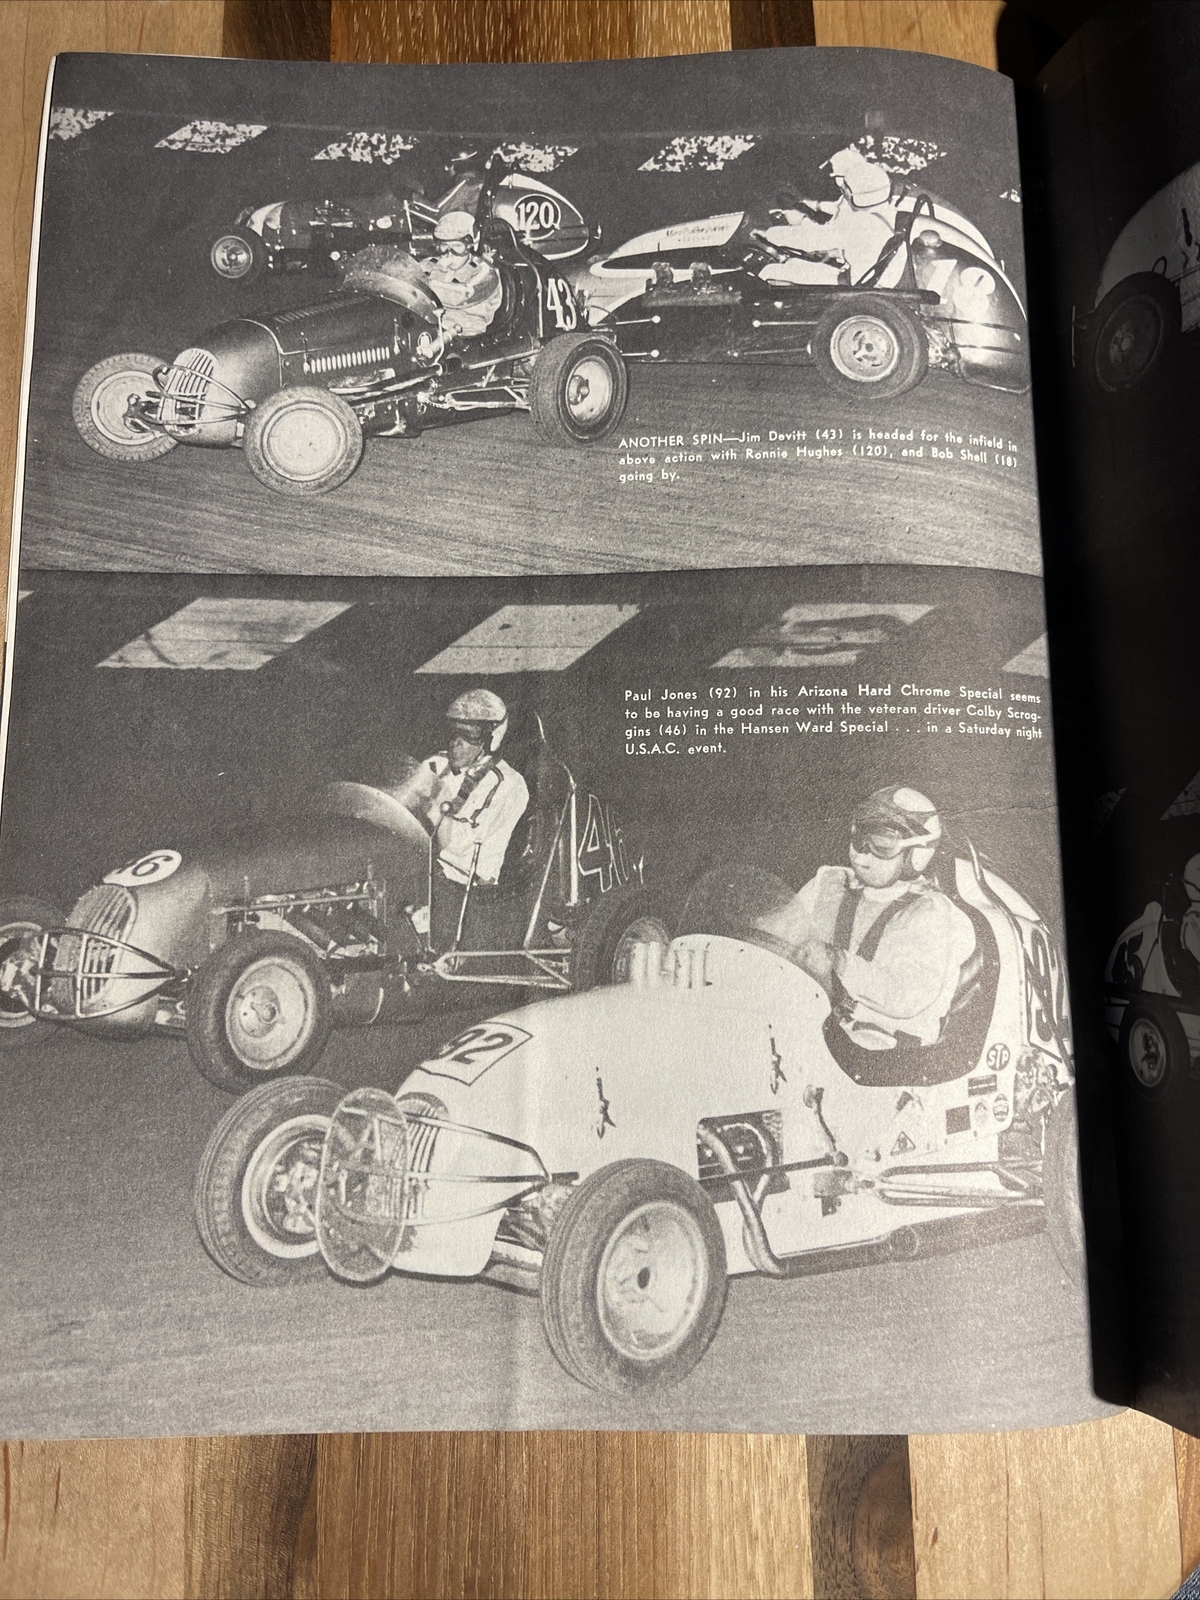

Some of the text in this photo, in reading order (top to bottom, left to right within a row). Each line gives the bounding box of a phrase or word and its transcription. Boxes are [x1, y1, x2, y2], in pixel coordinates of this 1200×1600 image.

[517, 202, 555, 231] 120
[547, 278, 577, 331] 43
[618, 434, 685, 449] ANOTHER
[768, 430, 808, 442] Devitt
[815, 428, 843, 441] (43)
[852, 428, 862, 440] is
[868, 427, 914, 441] headed
[920, 428, 939, 442] for
[944, 431, 963, 444] the
[968, 433, 1003, 450] infield
[1007, 440, 1018, 453] in
[618, 444, 1018, 469] above action with Ronnie Hughes (120), and Bob Shell (18)
[618, 468, 681, 484] going by.
[624, 683, 1042, 704] Paul Jones (92) in his Arizona Hard Chrome Special seems
[624, 701, 1042, 724] to be having a good race with the veteran driver Colby Scrog-
[624, 725, 651, 740] gins
[658, 723, 687, 737] (46)
[695, 723, 707, 736] in
[713, 722, 735, 735] the
[740, 722, 790, 735] Hansen
[795, 720, 833, 733] Ward
[839, 720, 889, 736] Special
[926, 721, 939, 733] in
[944, 725, 952, 734] a
[958, 721, 1012, 739] Saturday
[1016, 725, 1043, 741] night
[625, 741, 727, 756] U.S.A.C. event.
[988, 1044, 1009, 1069] STP
